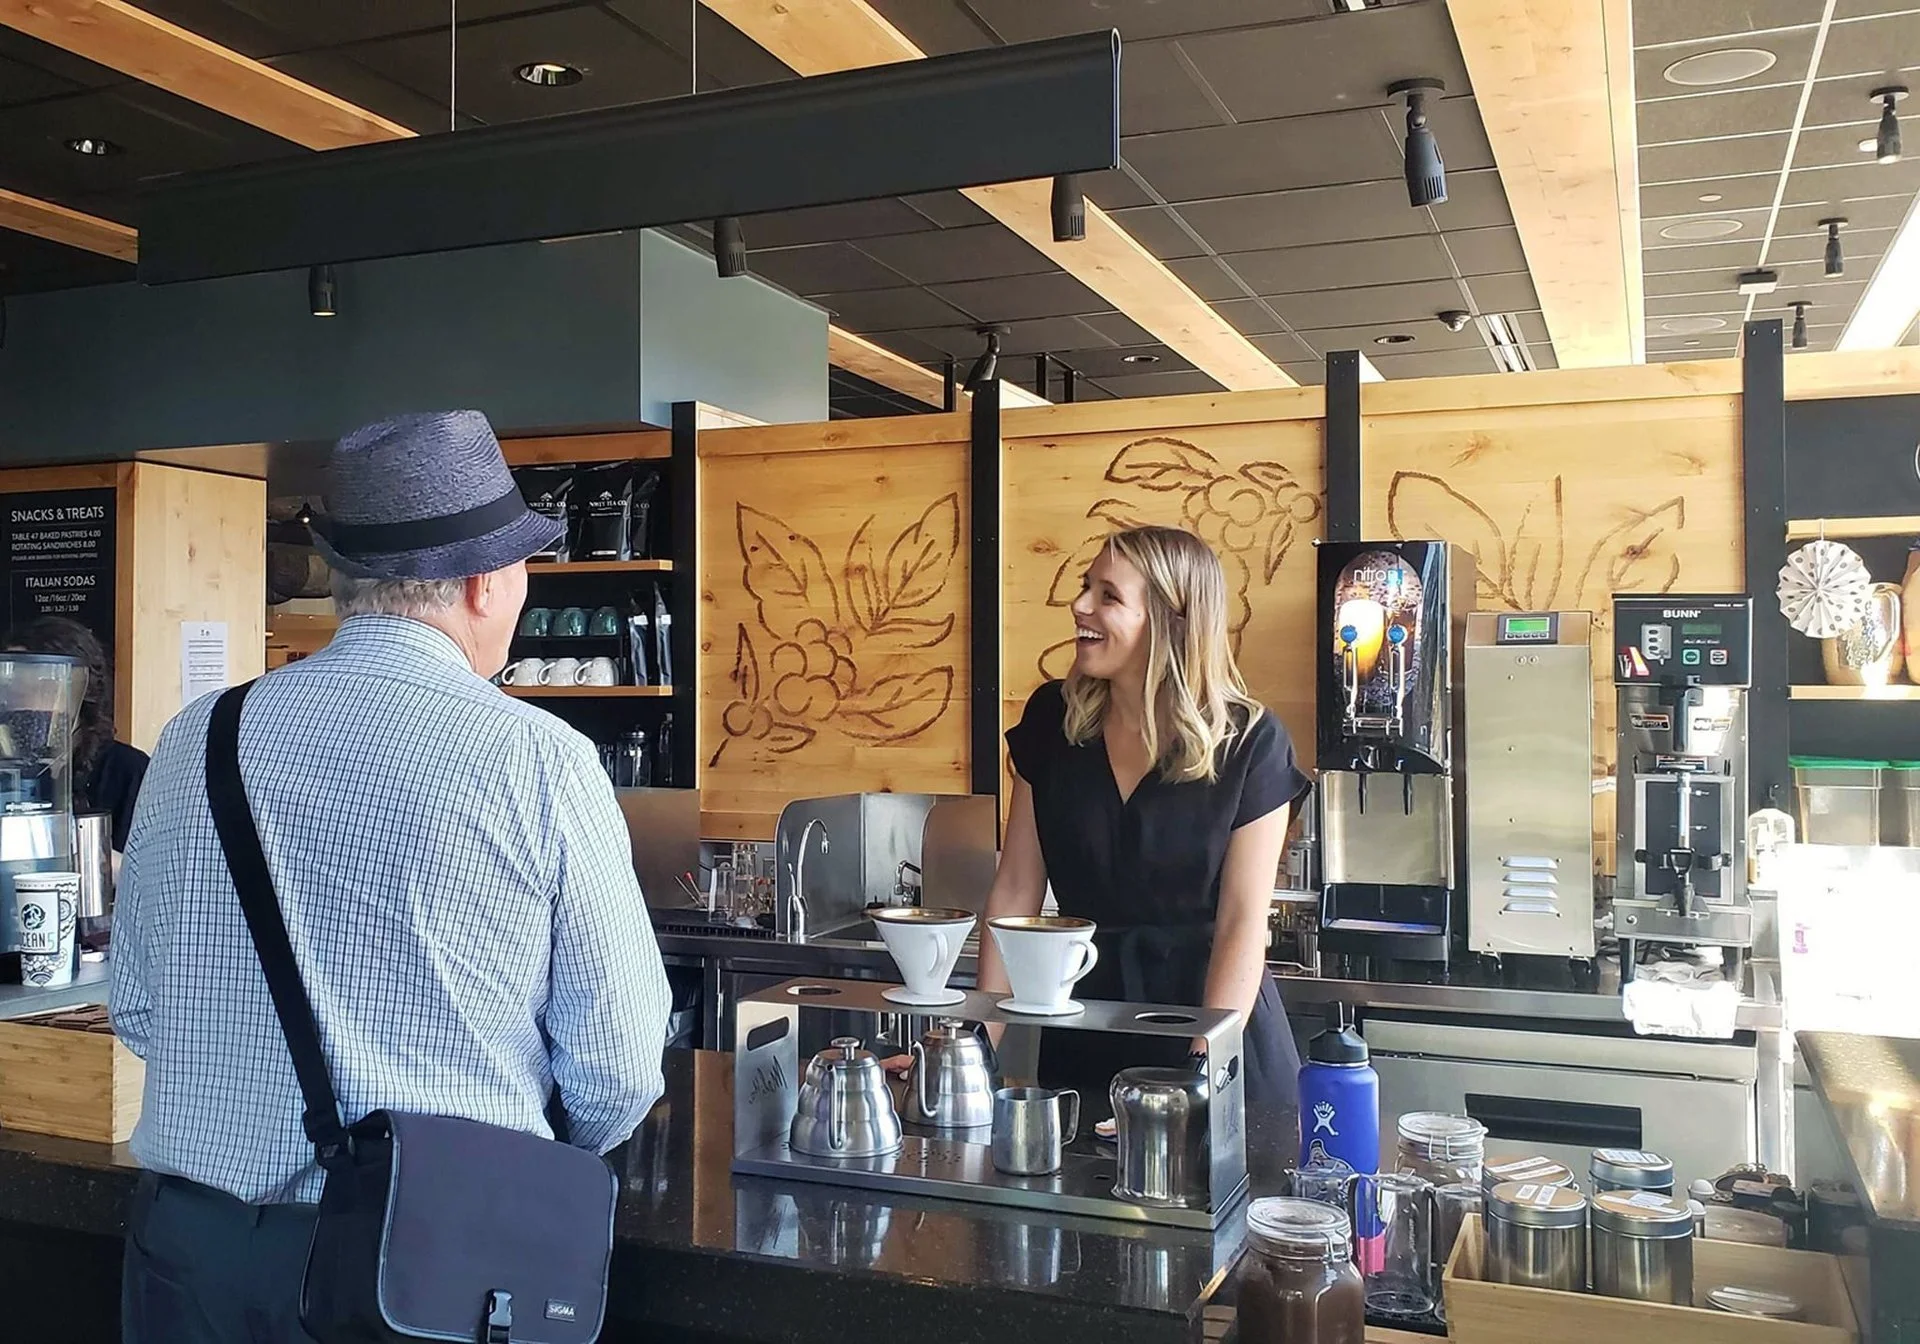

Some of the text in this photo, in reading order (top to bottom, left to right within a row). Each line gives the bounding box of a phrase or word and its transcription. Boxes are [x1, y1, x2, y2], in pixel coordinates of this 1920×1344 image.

[11, 506, 104, 522] SNACKS & TREATS
[11, 532, 30, 541] TABLE
[40, 531, 60, 540] BAKED
[61, 530, 88, 539] PASTRIES
[11, 542, 42, 551] ROTATING
[42, 540, 82, 550] SANDWICHES
[25, 575, 96, 588] ITALIAN SODAS
[1662, 609, 1698, 619] BUNN
[549, 1304, 576, 1317] SIGMA
